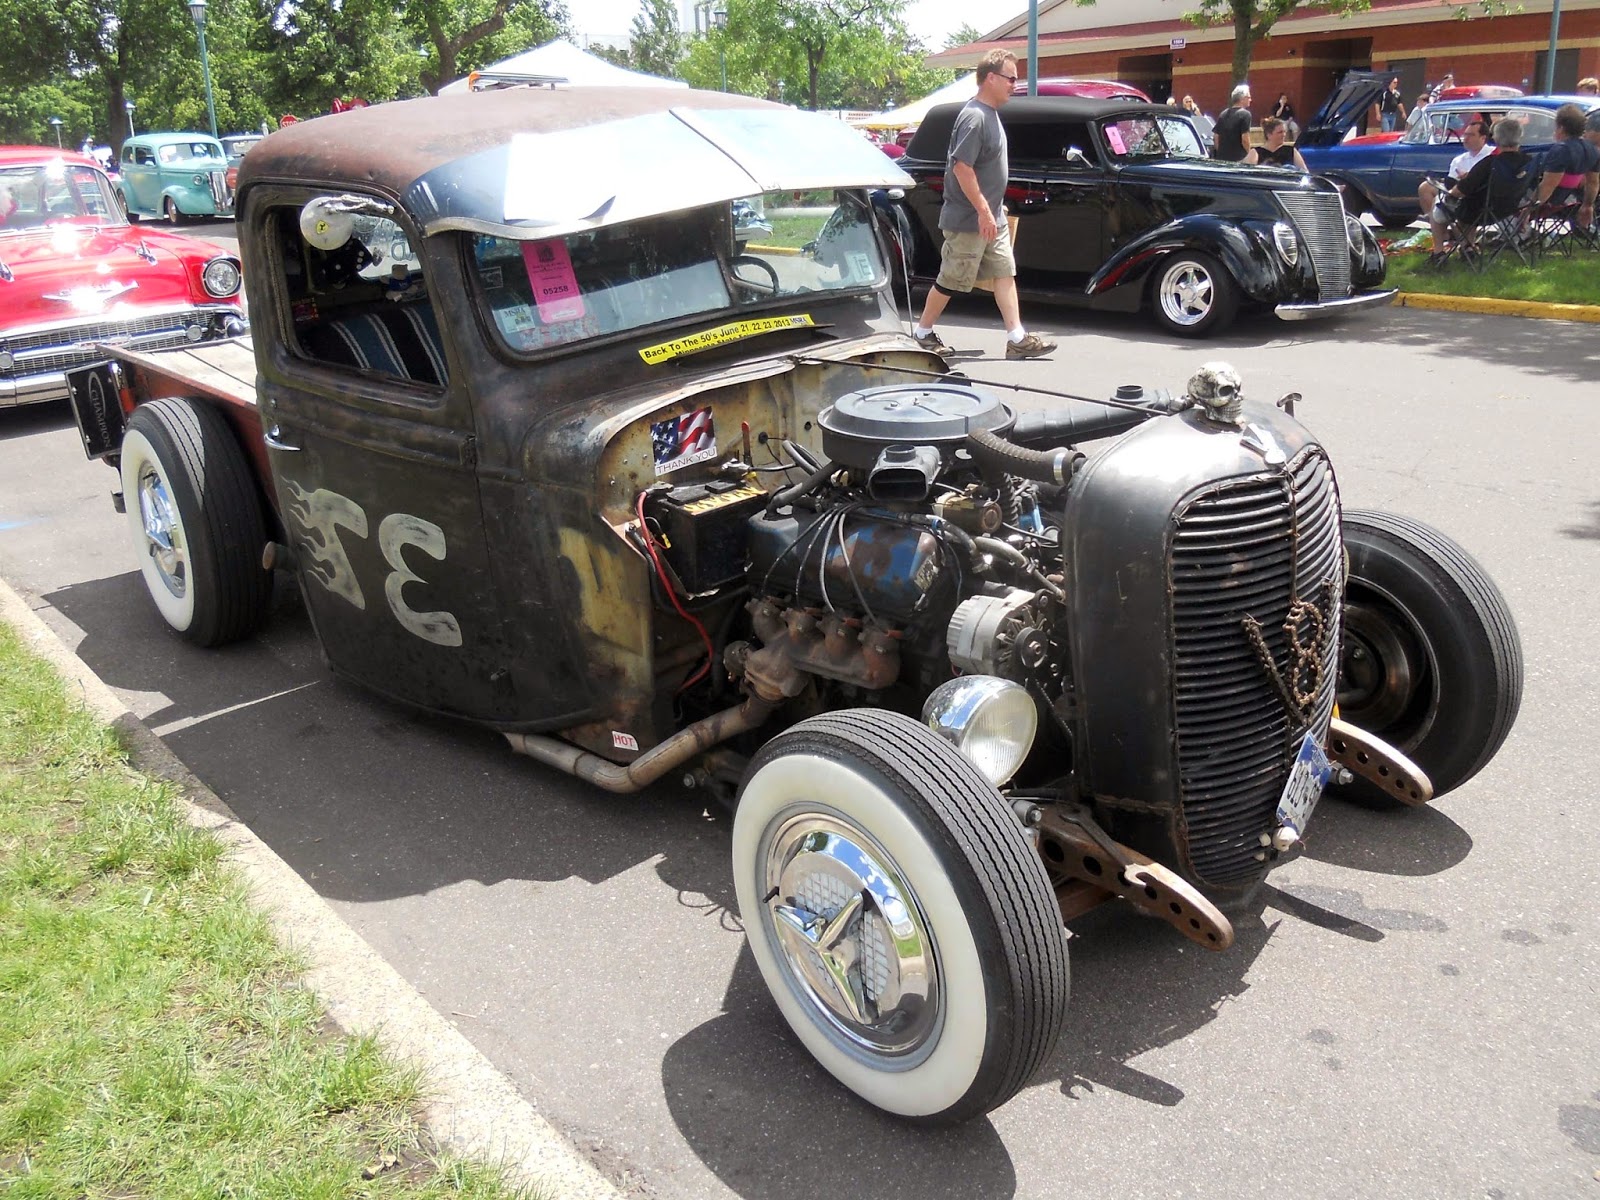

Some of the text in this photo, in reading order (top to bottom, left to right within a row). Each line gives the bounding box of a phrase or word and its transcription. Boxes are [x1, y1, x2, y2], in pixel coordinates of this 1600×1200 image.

[543, 285, 569, 295] 05258
[644, 346, 668, 358] Back
[668, 343, 681, 351] To
[682, 338, 699, 348] The
[700, 332, 718, 343] 50's
[720, 326, 739, 338] June
[774, 319, 791, 328] 2013
[91, 389, 112, 448] CHAMPION
[656, 447, 717, 474] THANK YOU
[613, 734, 634, 746] HOT
